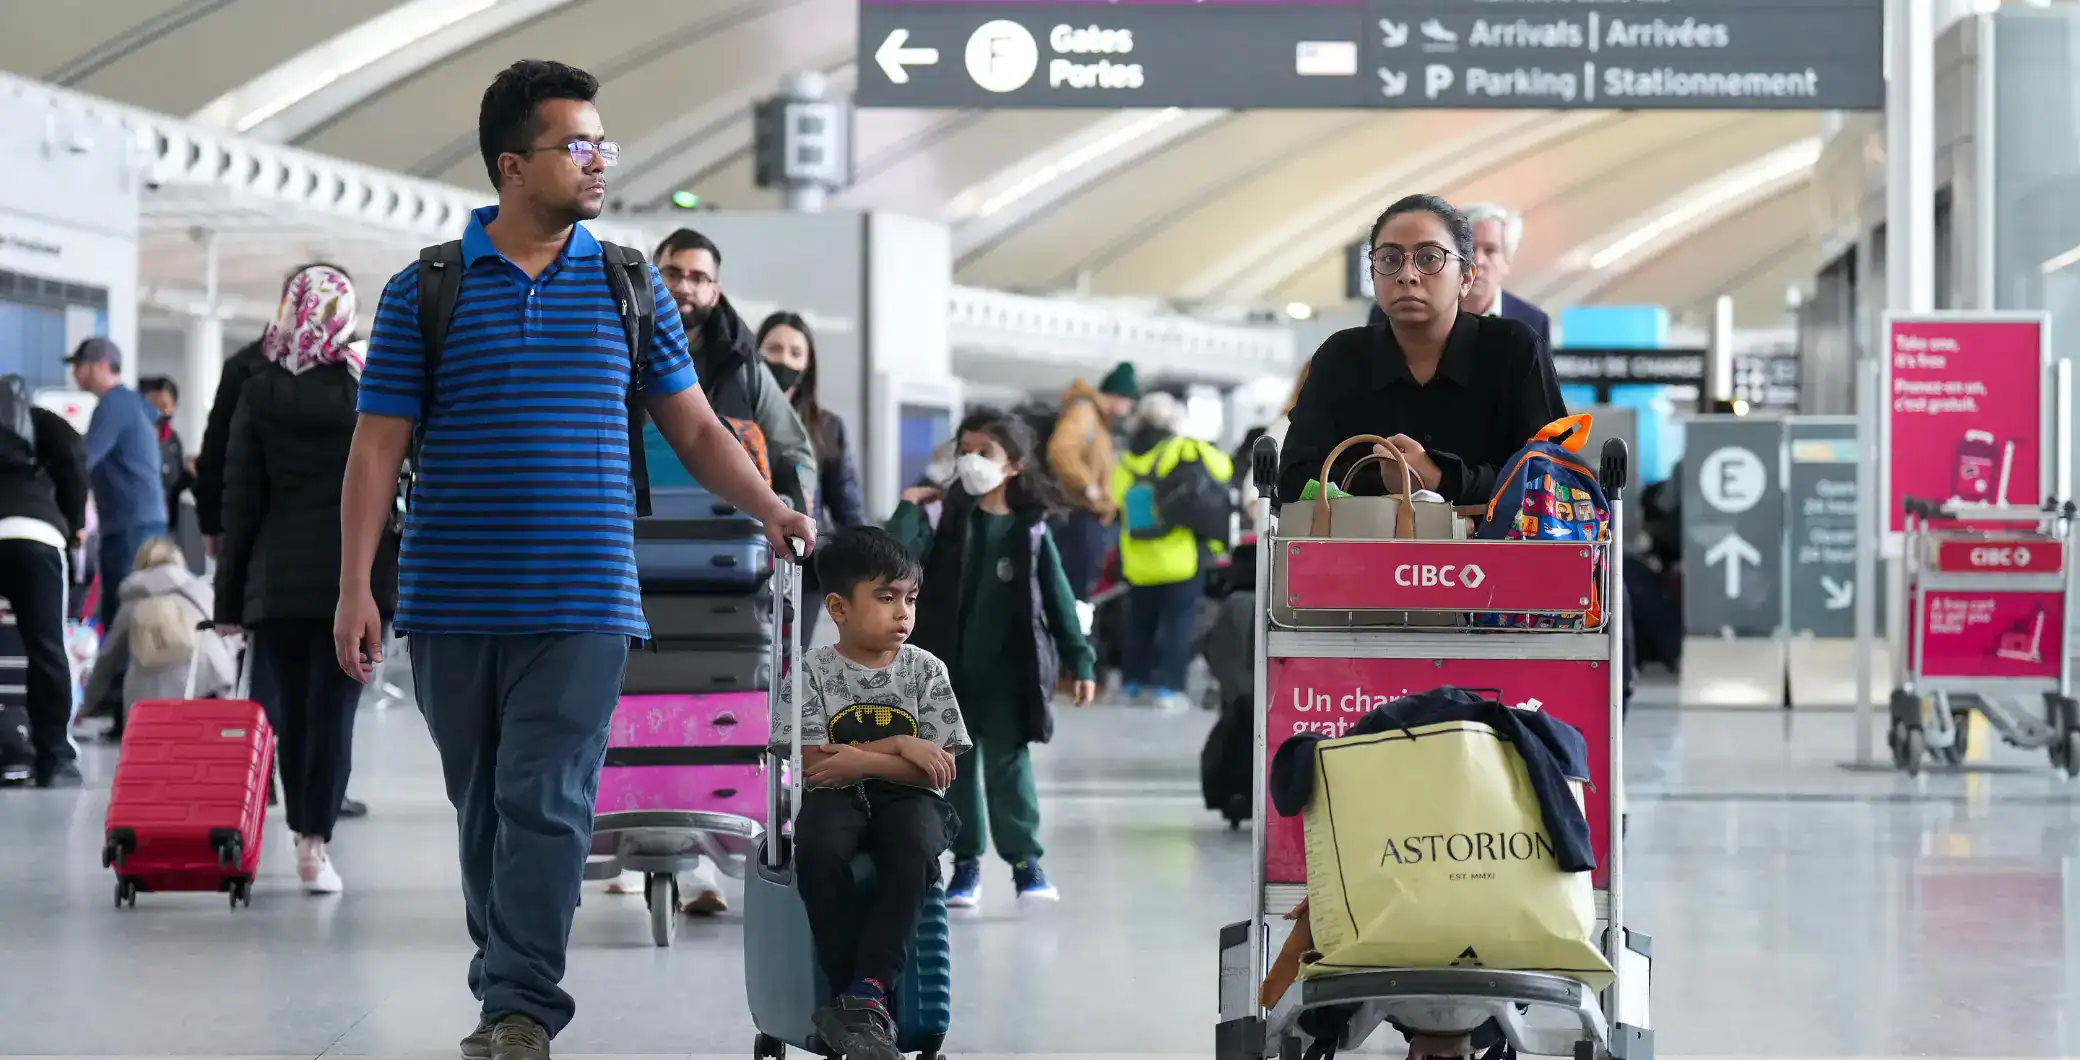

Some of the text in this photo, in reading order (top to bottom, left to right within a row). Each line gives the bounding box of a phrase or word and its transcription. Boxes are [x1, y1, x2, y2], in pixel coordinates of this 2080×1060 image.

[1050, 24, 1133, 53] Gates
[1469, 17, 1729, 47] Arrivals Arrivées
[989, 36, 1012, 74] F
[1049, 59, 1144, 88] Portes
[1425, 64, 1818, 101] P Parking Stationnement
[1721, 461, 1746, 499] E
[1970, 547, 2011, 566] CIBC
[1395, 564, 1456, 587] CIBC
[1293, 687, 1408, 712] Un char
[1293, 716, 1355, 738] grat
[1380, 831, 1557, 867] ASTORION
